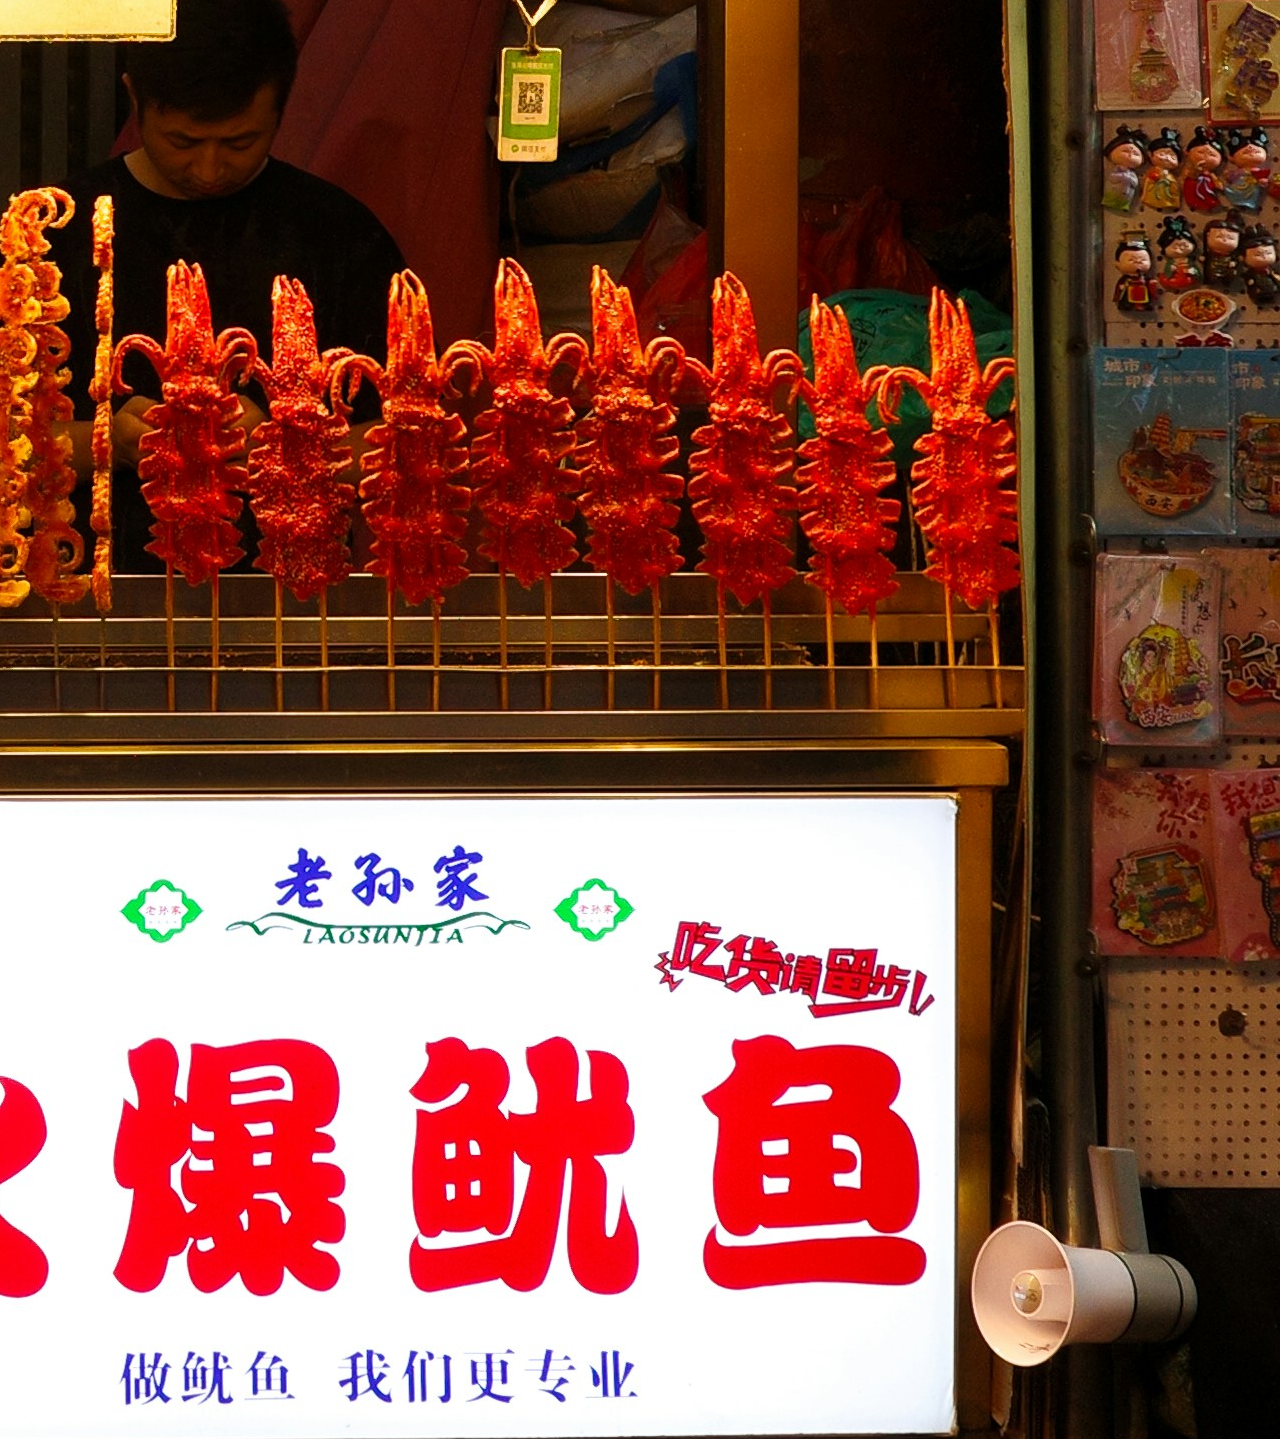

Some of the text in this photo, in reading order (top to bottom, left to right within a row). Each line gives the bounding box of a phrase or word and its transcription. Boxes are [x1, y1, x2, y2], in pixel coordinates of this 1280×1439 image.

[275, 845, 489, 912] 老孙家
[302, 927, 465, 947] LAOSUNJIA
[121, 1349, 638, 1405] 做鱿鱼 我们更专业
